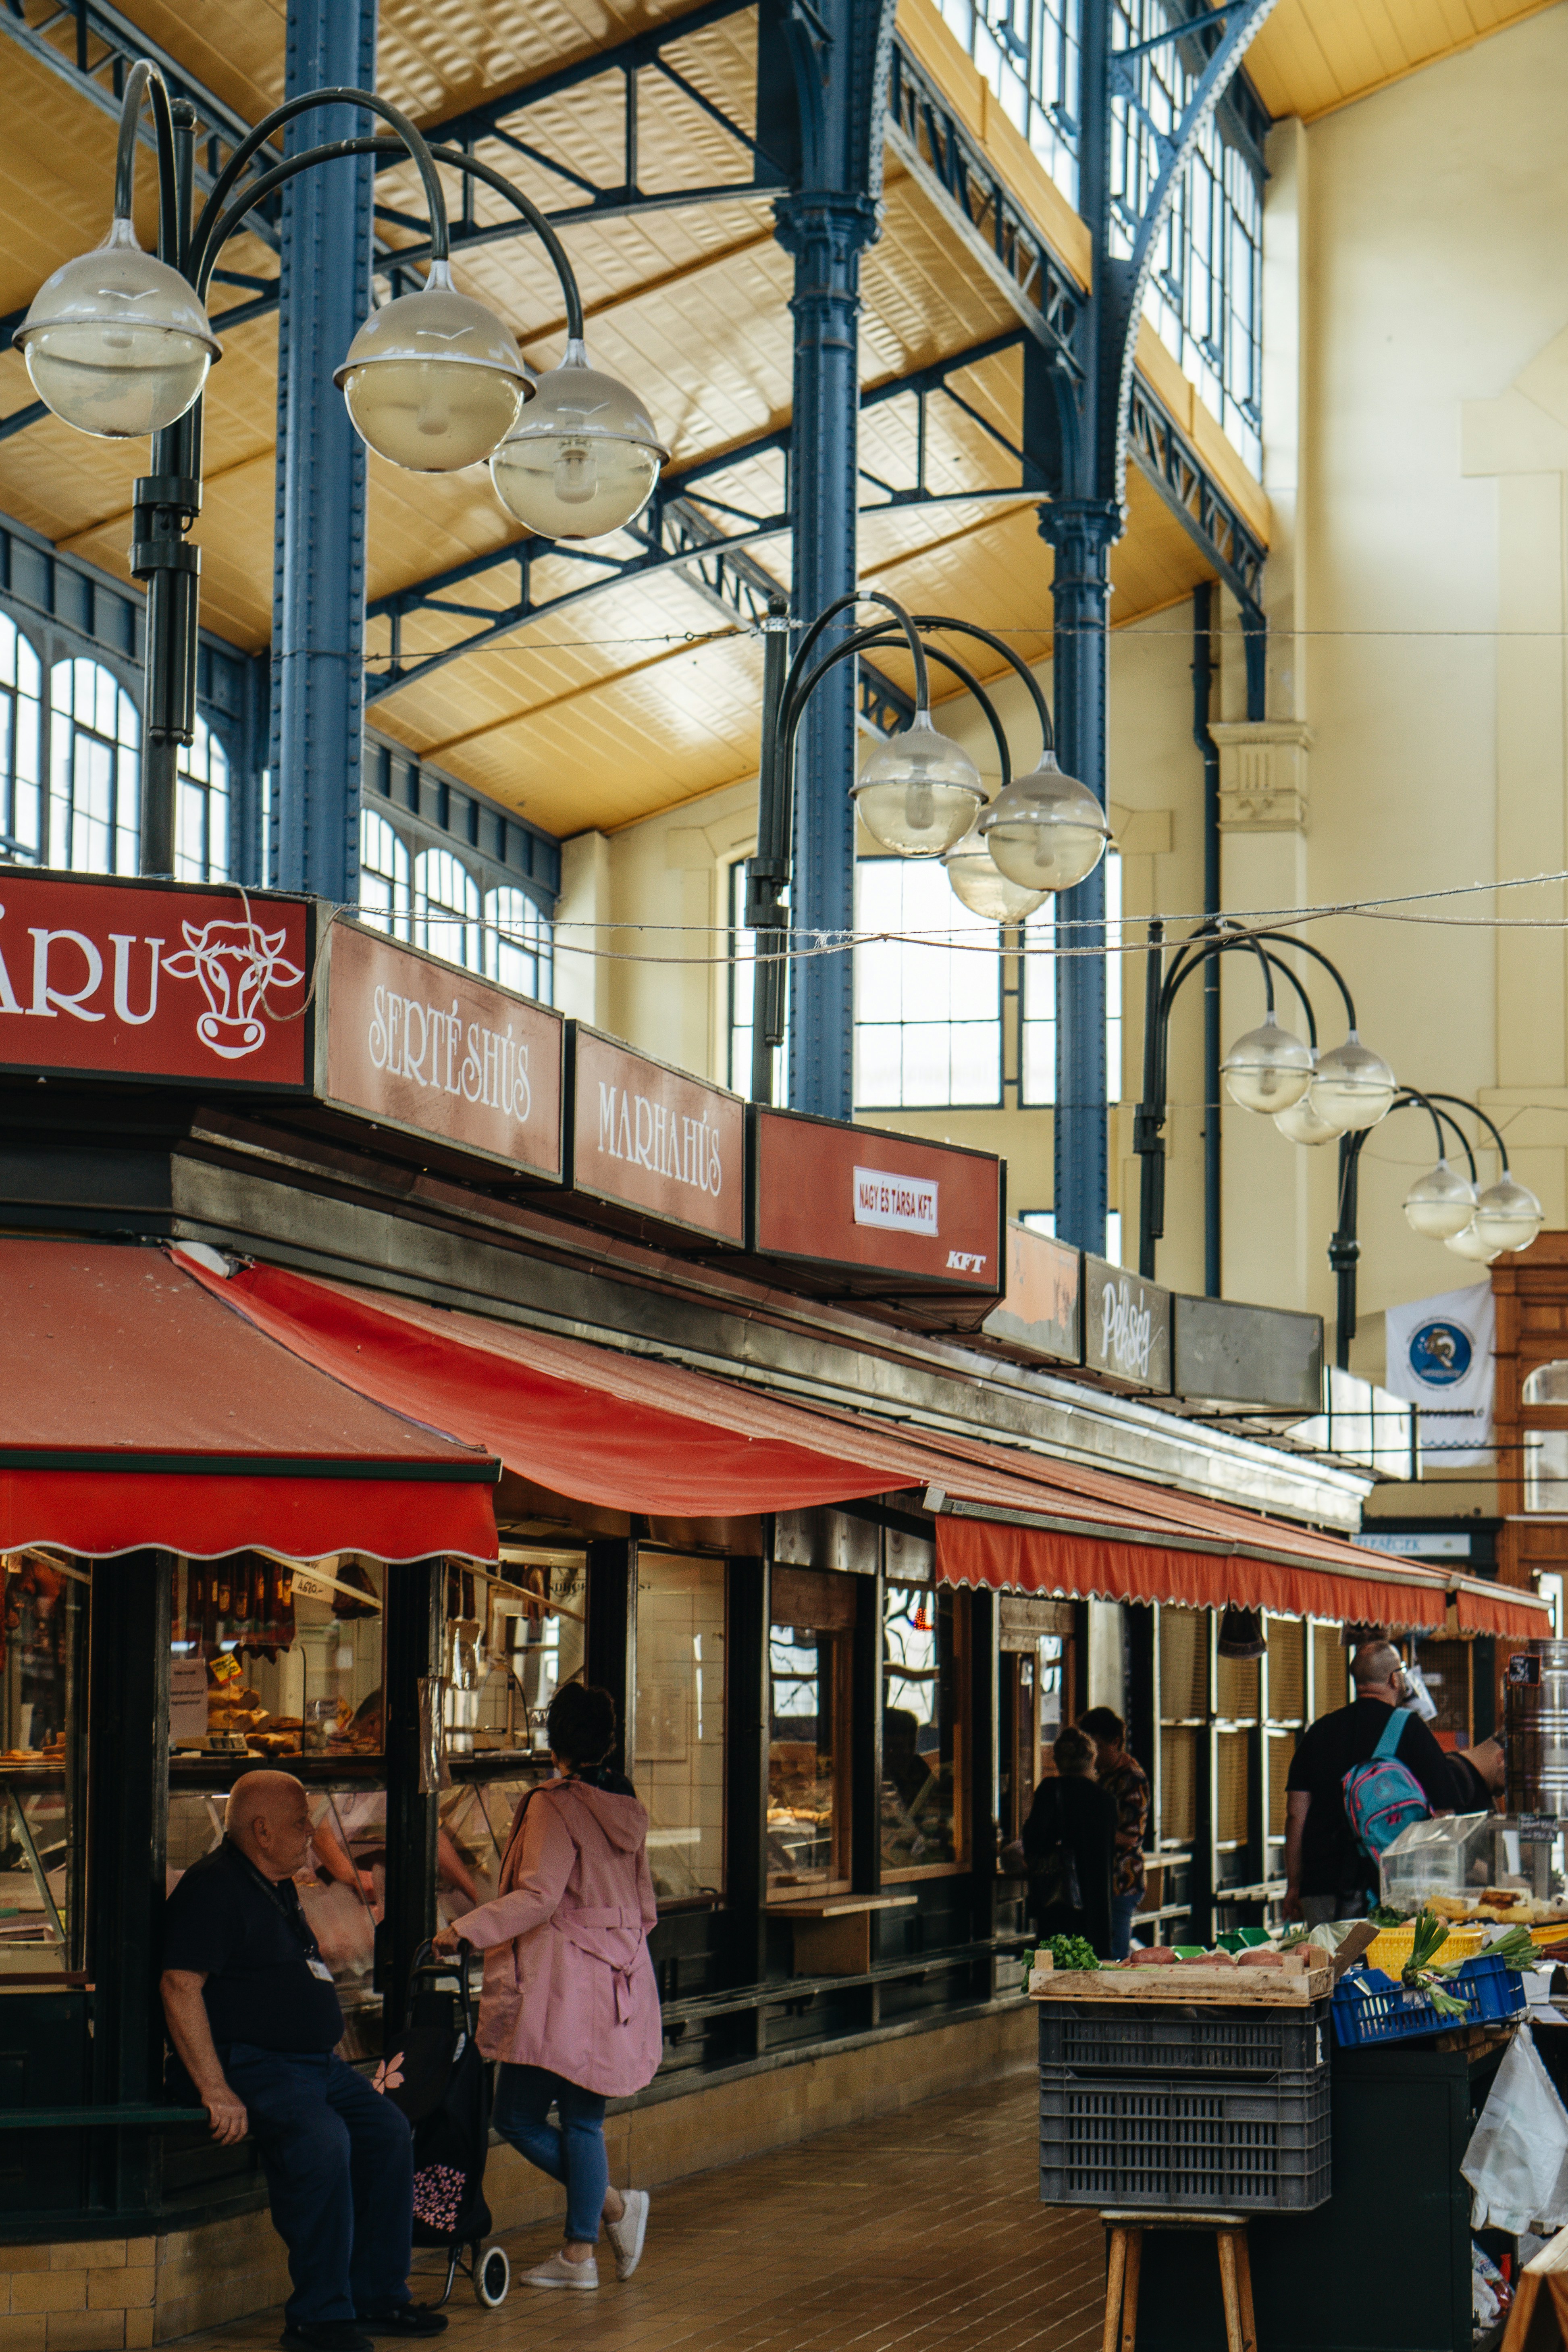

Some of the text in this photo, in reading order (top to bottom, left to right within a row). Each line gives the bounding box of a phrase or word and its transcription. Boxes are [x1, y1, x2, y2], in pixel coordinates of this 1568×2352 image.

[598, 1081, 722, 1197] MARHAHÚS
[859, 1181, 933, 1221] NAGY ÉS TÁRSA KFT.
[946, 1250, 987, 1273] KFT
[1100, 1279, 1165, 1378] Pékség
